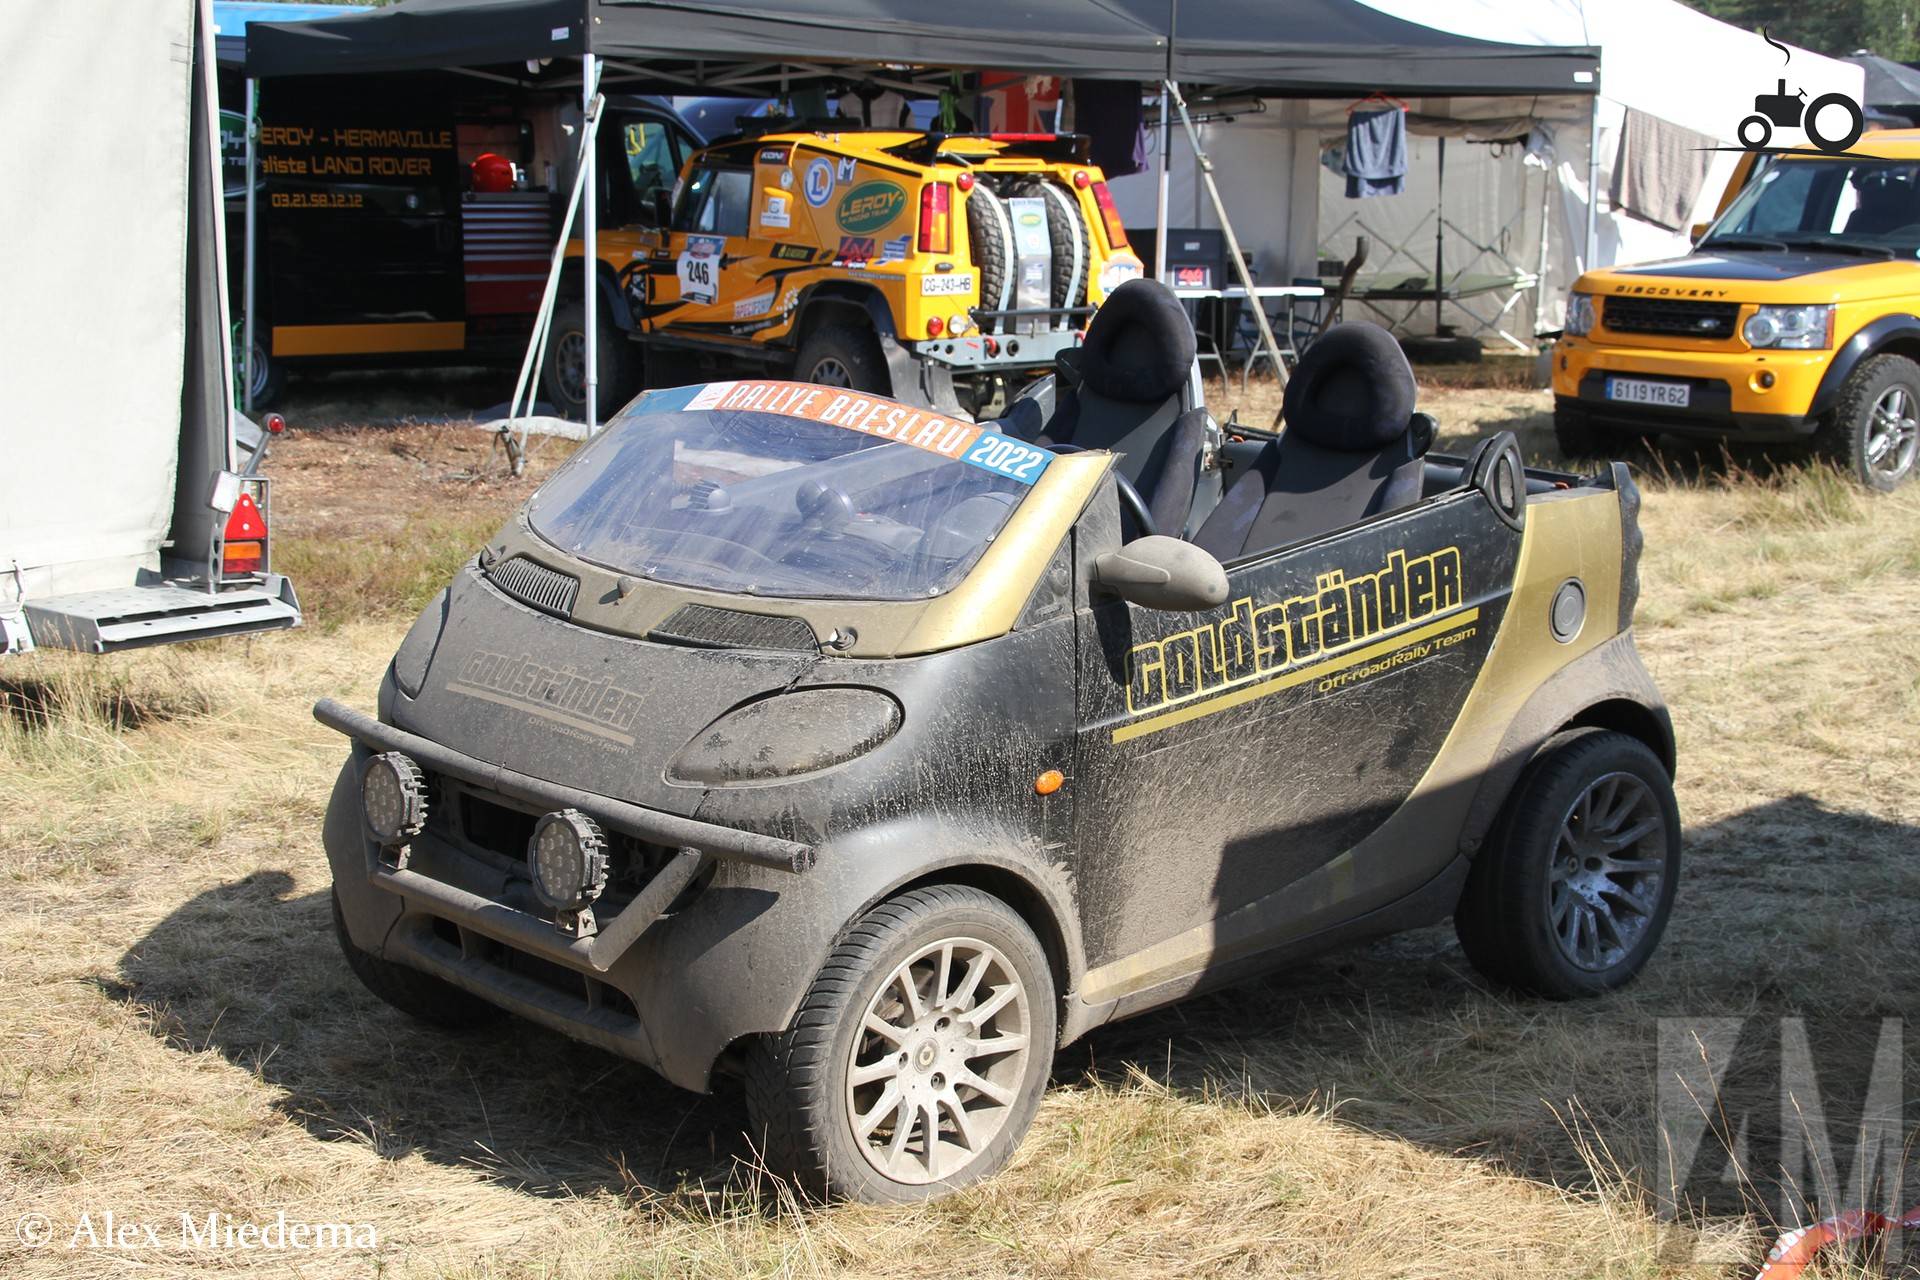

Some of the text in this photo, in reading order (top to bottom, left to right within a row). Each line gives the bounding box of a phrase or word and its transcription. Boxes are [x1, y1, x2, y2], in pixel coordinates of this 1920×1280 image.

[260, 127, 314, 146] EROY
[333, 129, 452, 149] HERMAVILLE
[312, 156, 364, 175] LAND
[368, 157, 432, 175] ROVER
[840, 191, 900, 217] LEROY
[686, 260, 710, 286] 246
[1615, 285, 1728, 297] DISCOVERY
[724, 383, 1044, 479] RALLYE BRESLAU 2022
[1432, 627, 1476, 651] Team
